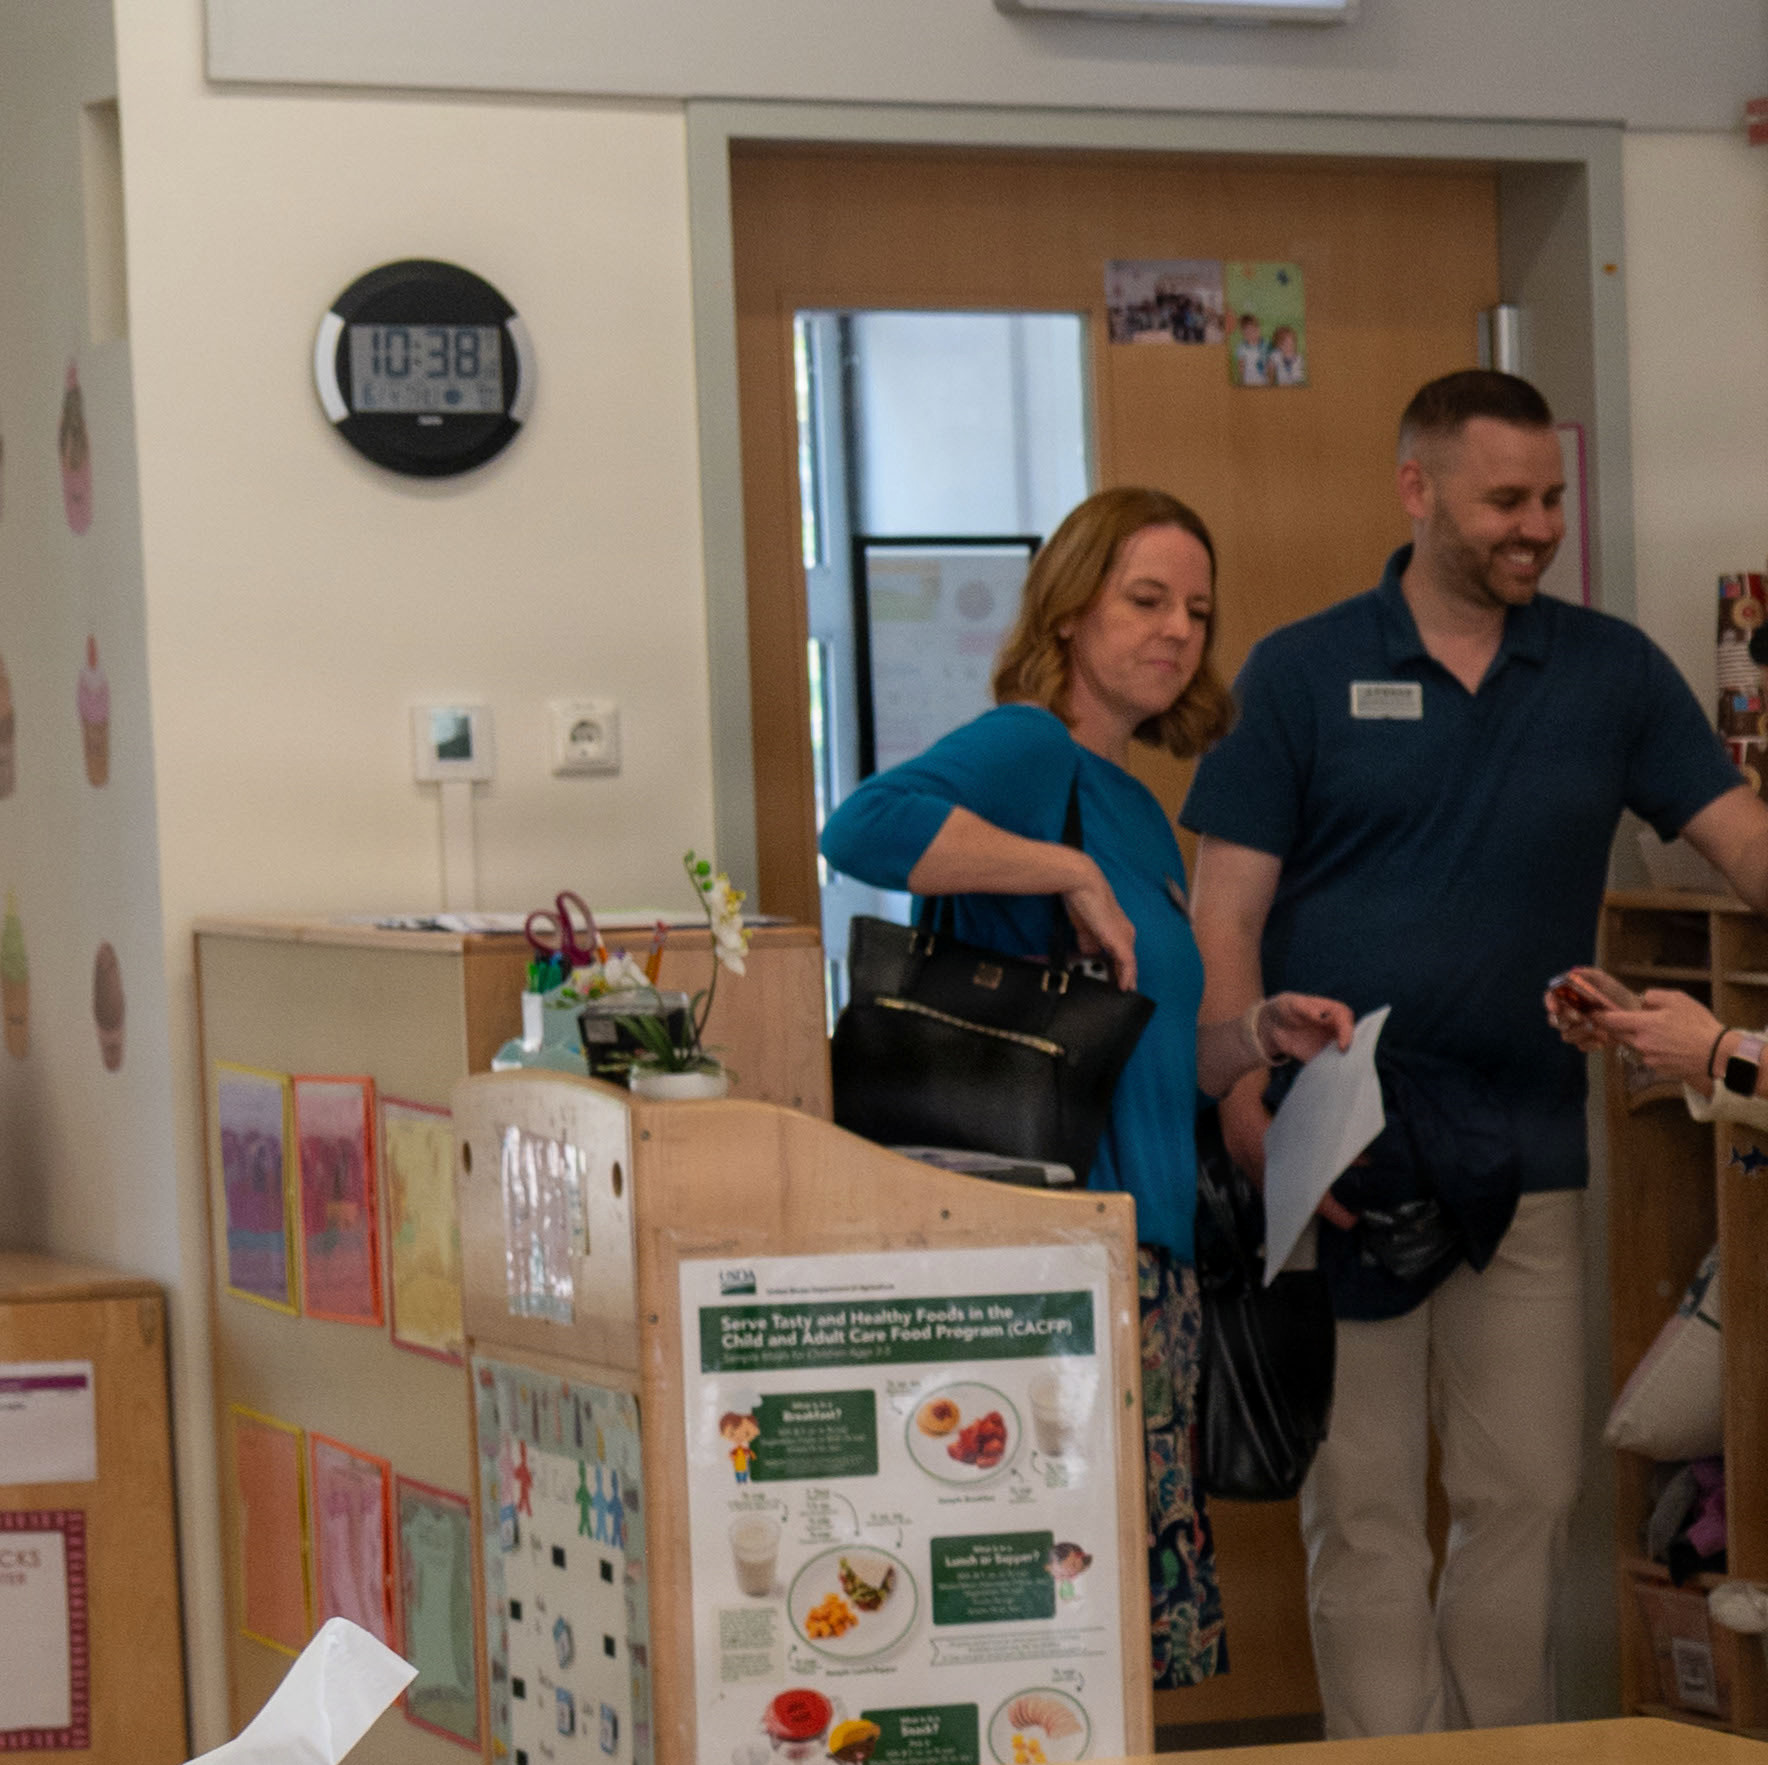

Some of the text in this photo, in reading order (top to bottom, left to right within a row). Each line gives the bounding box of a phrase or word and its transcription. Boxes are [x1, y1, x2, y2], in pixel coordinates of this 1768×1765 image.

[372, 328, 479, 378] 10:38
[721, 1304, 1014, 1332] Serve Tasty and Healthy Foods in the
[721, 1318, 1073, 1349] Child and Adult Care Food Program (CACFP)
